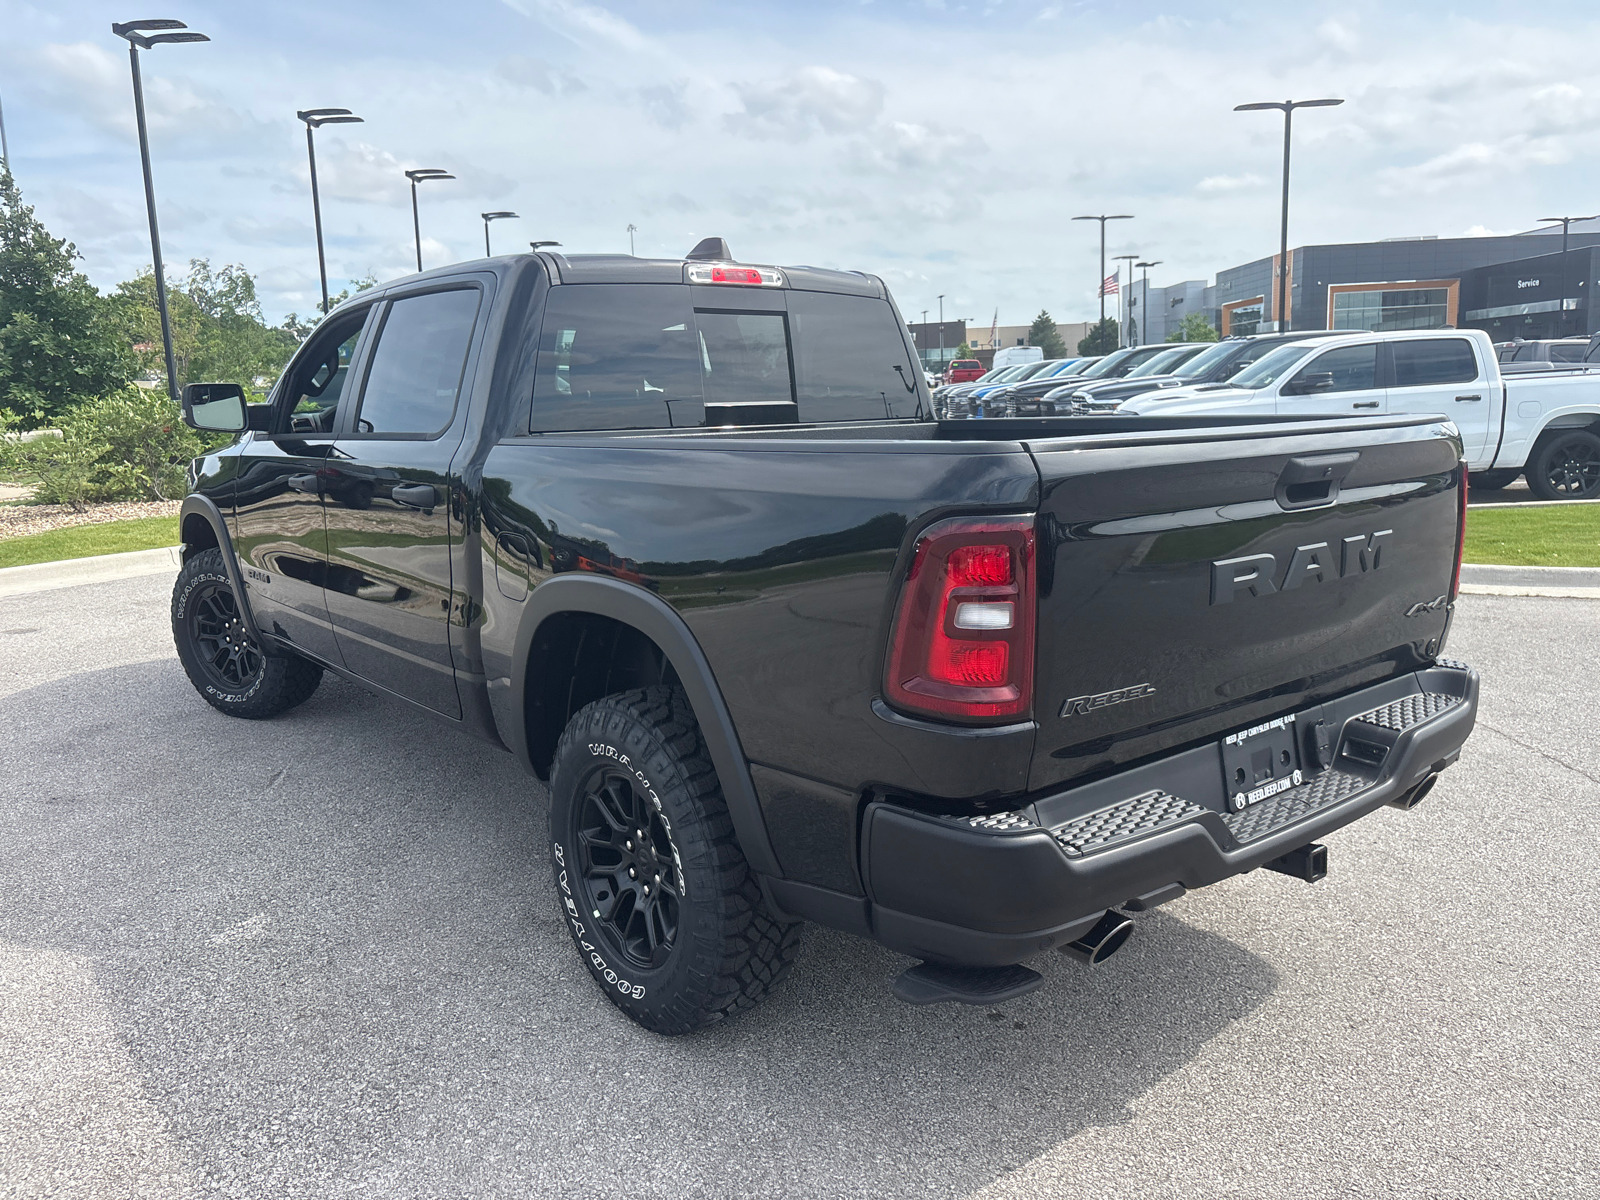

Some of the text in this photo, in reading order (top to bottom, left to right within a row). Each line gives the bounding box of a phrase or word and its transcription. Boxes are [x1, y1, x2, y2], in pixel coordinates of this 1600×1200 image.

[1517, 278, 1540, 289] Service
[247, 569, 271, 584] RAM
[1209, 529, 1393, 606] RAM
[205, 655, 267, 702] GOODYEAR
[1058, 682, 1156, 718] REBEL
[1225, 713, 1296, 745] REED JEEP CHRYSLER DODGE RAM
[1247, 777, 1291, 804] REEDJEEP.COM
[588, 743, 686, 896] WRANGLER
[554, 843, 646, 1000] GOODYEAR
